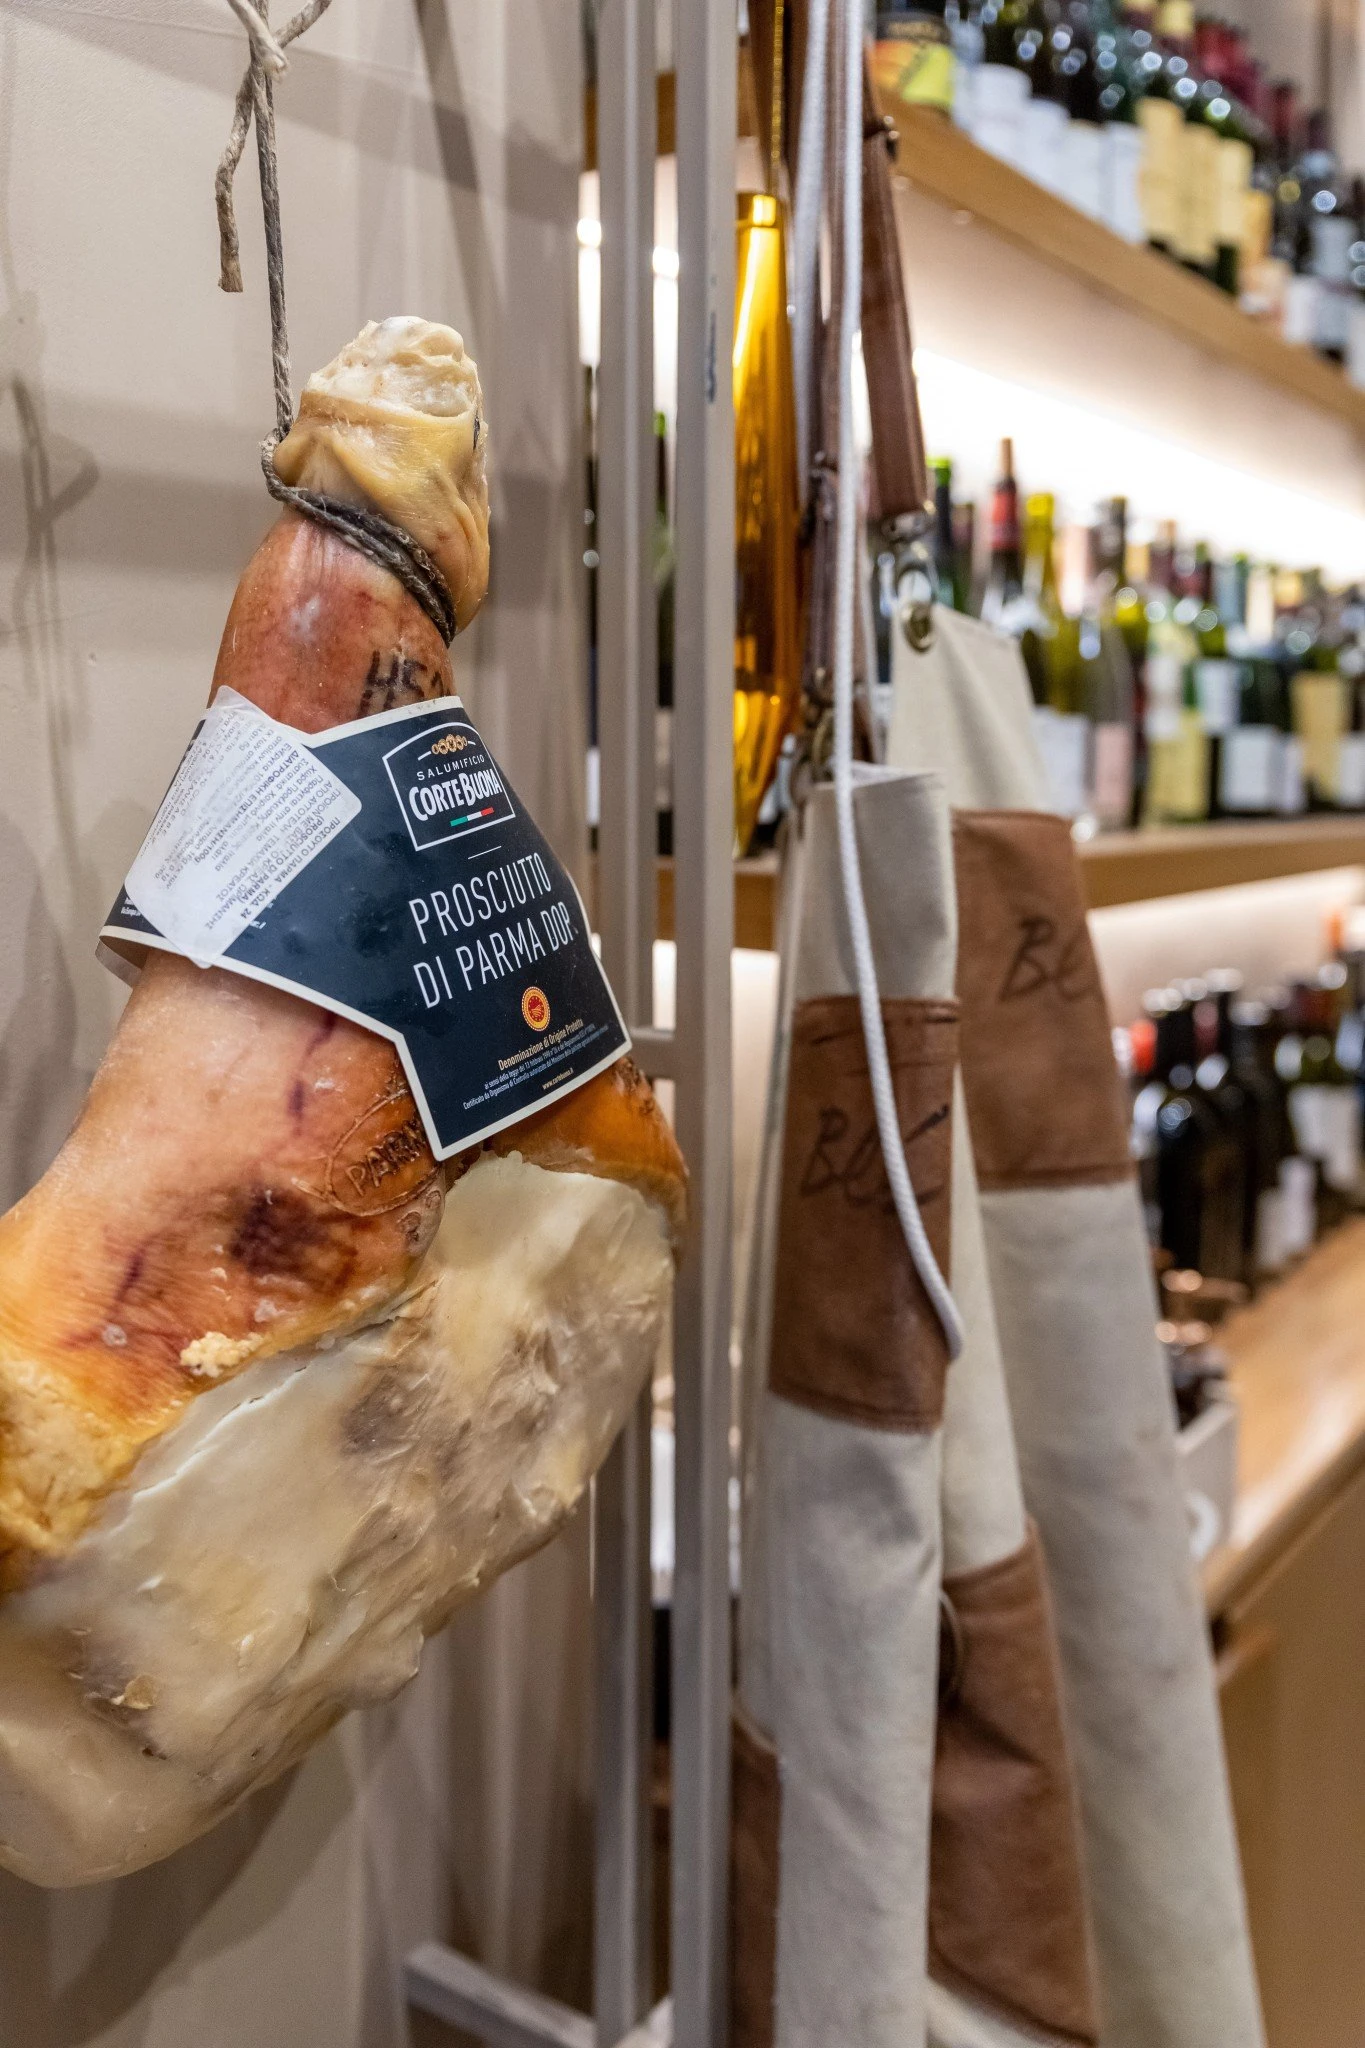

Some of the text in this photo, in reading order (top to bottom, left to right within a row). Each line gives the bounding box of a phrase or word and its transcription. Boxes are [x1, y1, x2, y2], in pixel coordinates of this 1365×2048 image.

[416, 754, 486, 781] SALUMIFICIO
[409, 852, 552, 945] PROSCIUTTO
[413, 956, 453, 1008] DI
[455, 917, 546, 991] PARMA
[498, 1041, 544, 1071] Denominazione
[548, 1029, 567, 1045] Origine
[565, 1018, 584, 1035] Protetta
